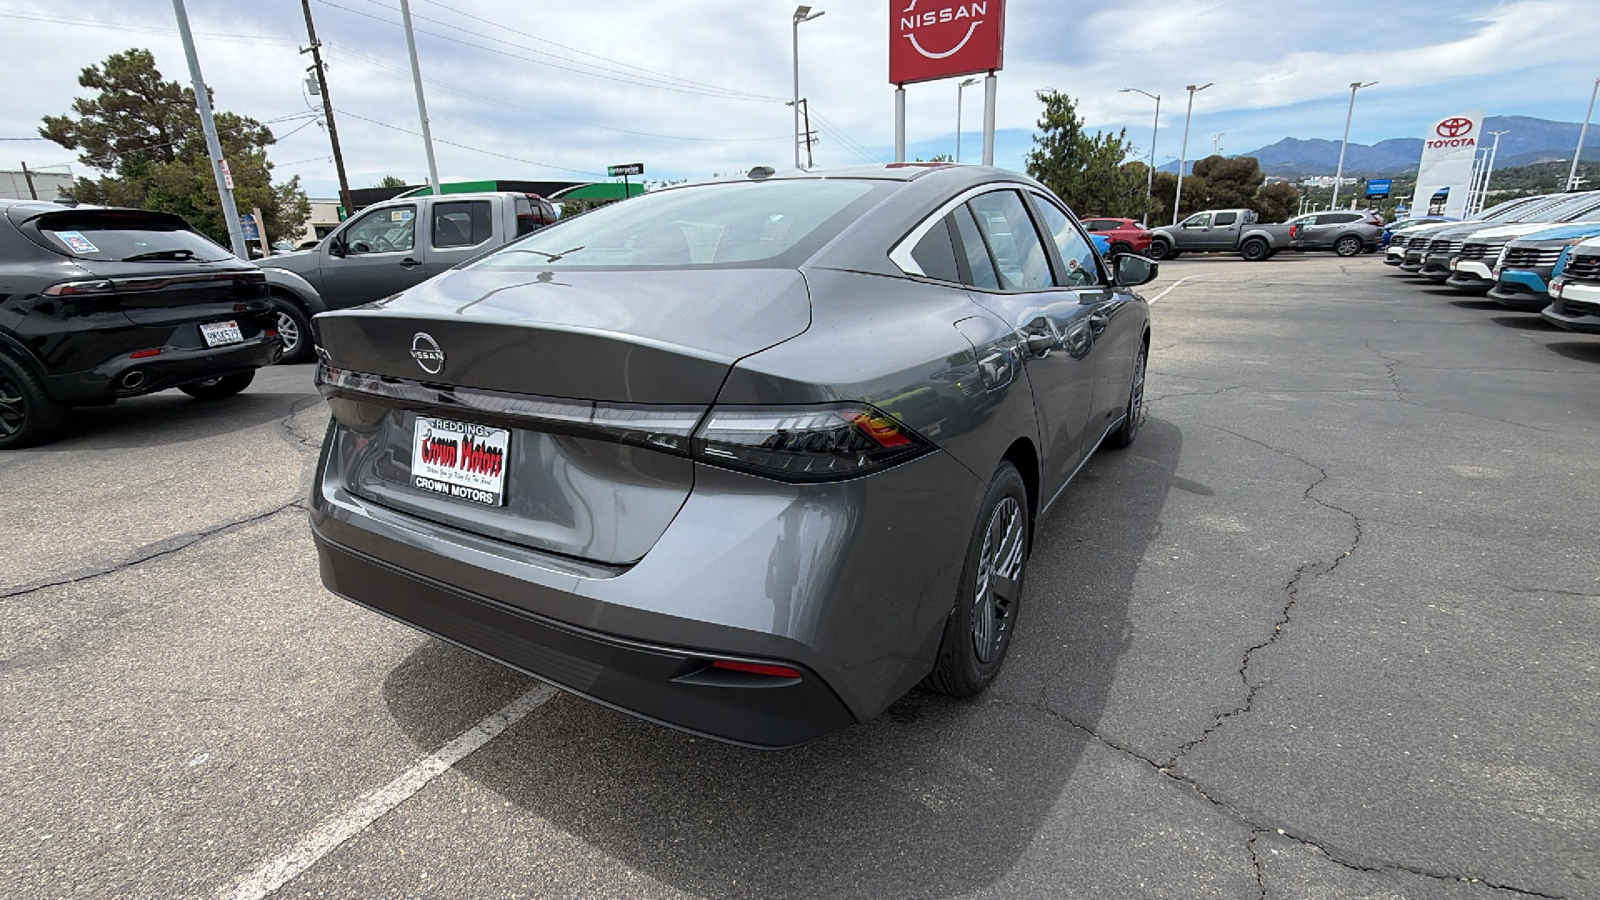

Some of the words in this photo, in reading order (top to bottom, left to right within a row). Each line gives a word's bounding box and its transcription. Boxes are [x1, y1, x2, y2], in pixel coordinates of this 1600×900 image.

[900, 1, 987, 31] NISSAN
[1426, 137, 1476, 149] TOYOTA
[410, 350, 444, 361] NISSAN
[436, 420, 484, 436] REDDING
[421, 435, 458, 469] Crown
[460, 434, 503, 478] Motors
[415, 477, 449, 494] CROWN
[451, 484, 493, 504] MOTORS
